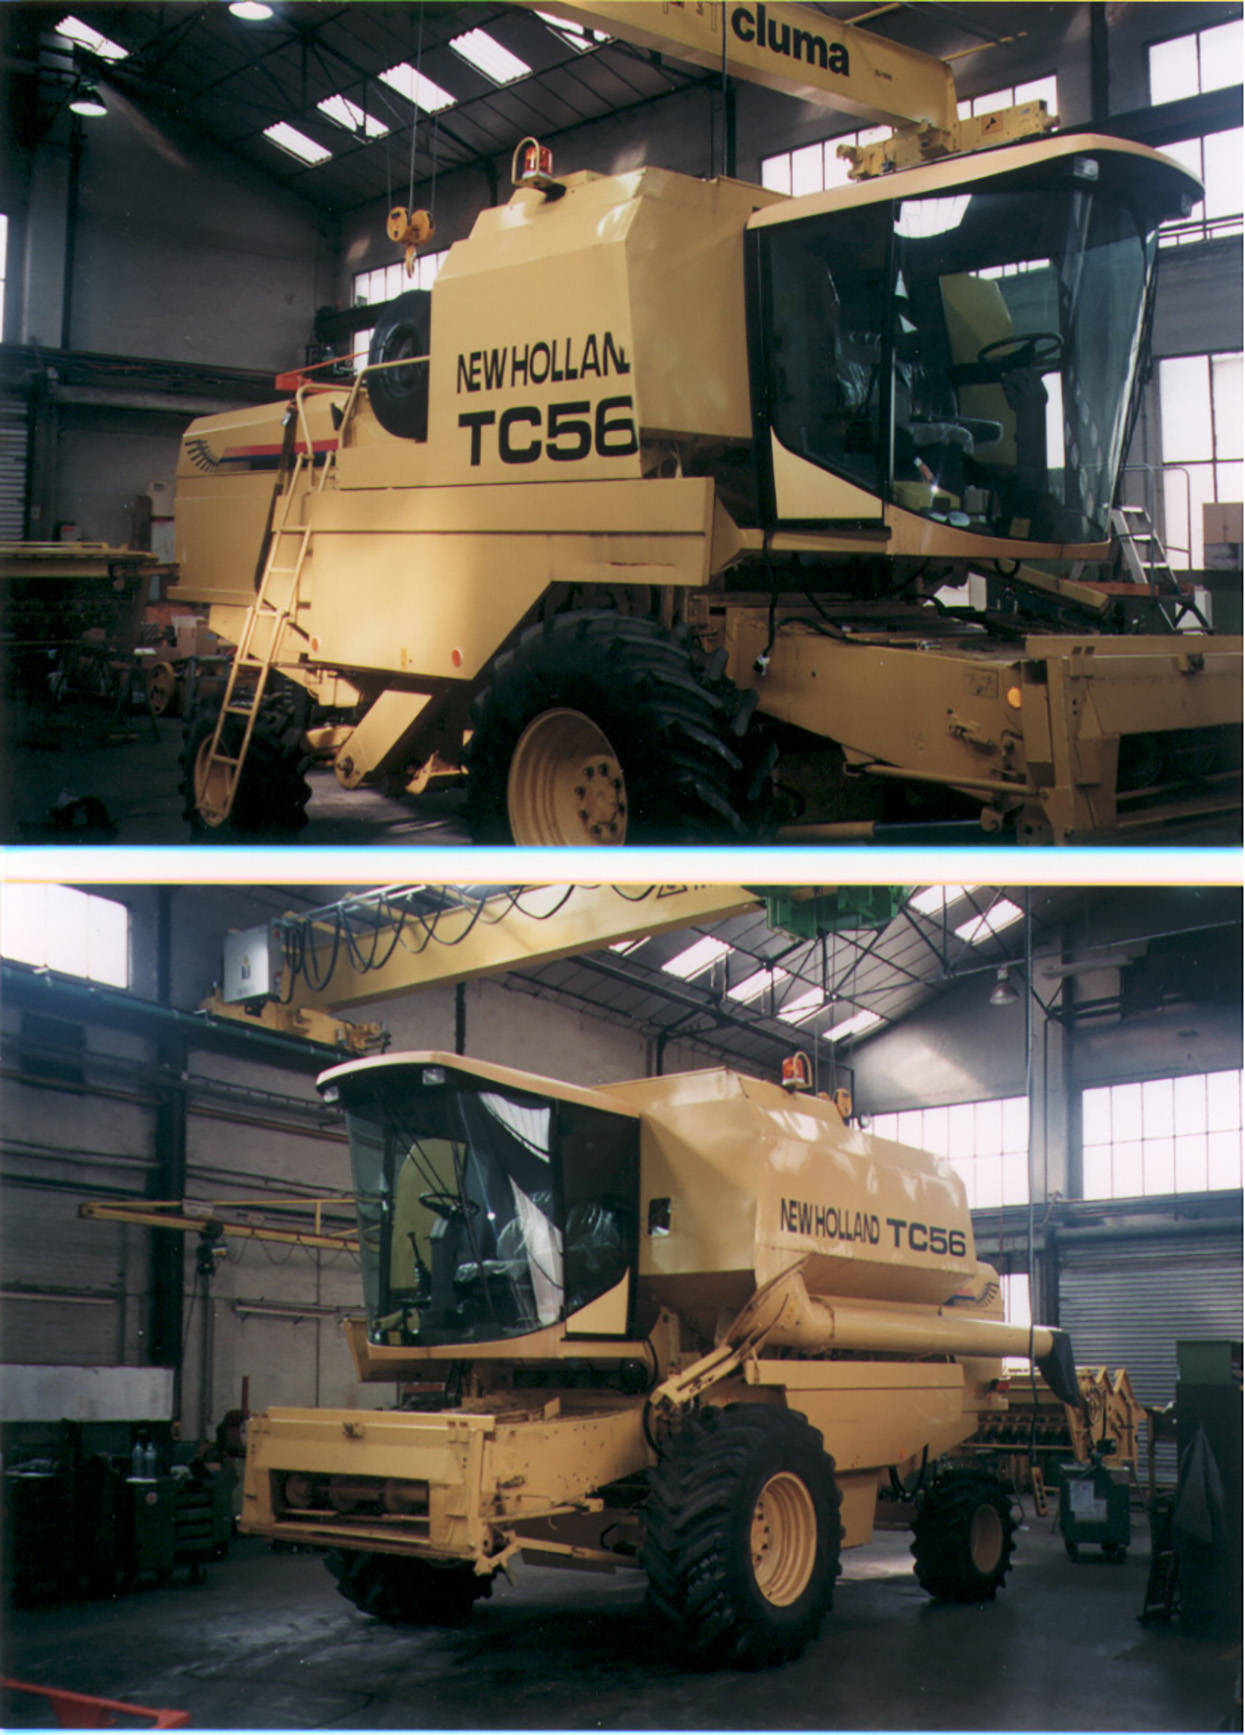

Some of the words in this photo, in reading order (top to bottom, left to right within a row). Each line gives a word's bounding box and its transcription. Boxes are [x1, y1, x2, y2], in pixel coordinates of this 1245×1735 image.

[731, 3, 850, 77] cluma
[457, 347, 508, 394] NEW
[511, 331, 631, 388] HOLLAN
[458, 395, 639, 467] TC56
[780, 1198, 813, 1235] NEW
[815, 1205, 880, 1245] HOLLAND
[886, 1217, 967, 1257] TC56
